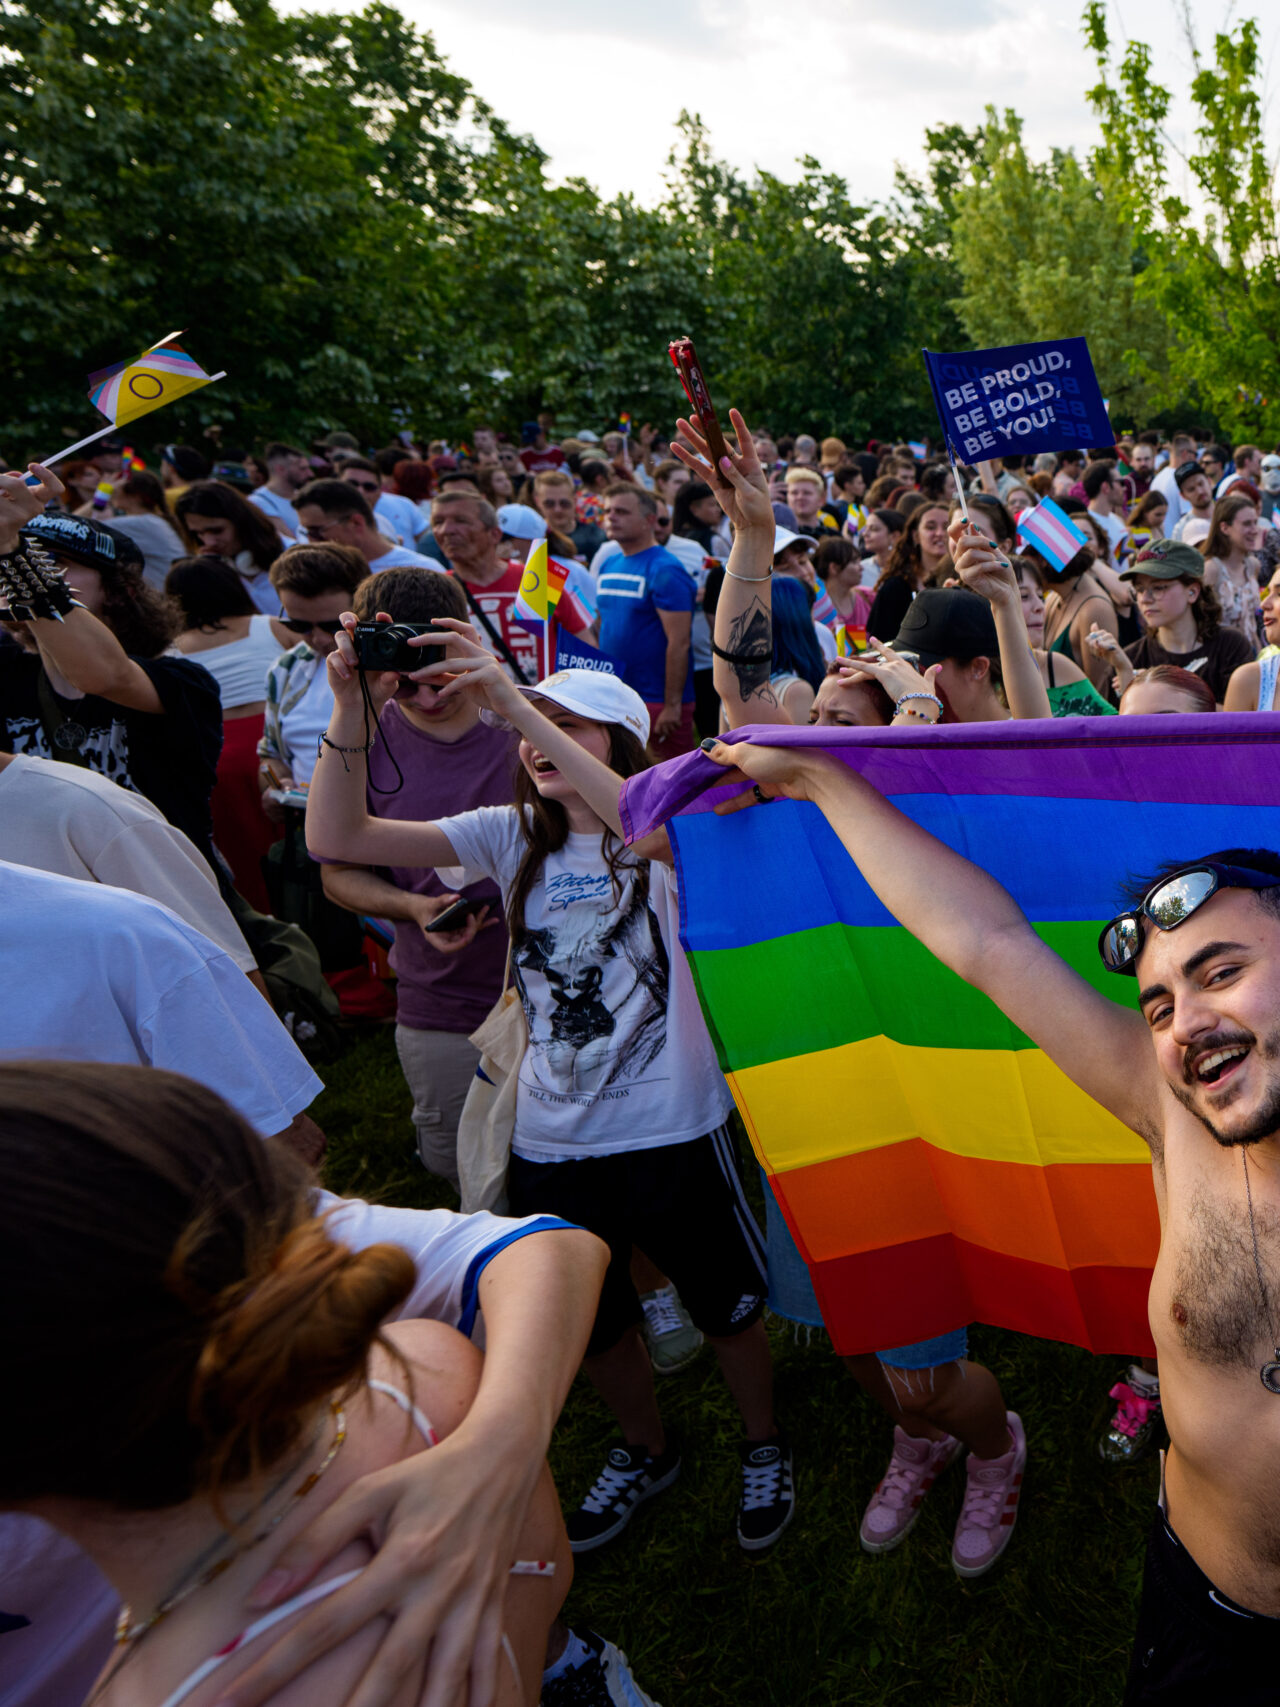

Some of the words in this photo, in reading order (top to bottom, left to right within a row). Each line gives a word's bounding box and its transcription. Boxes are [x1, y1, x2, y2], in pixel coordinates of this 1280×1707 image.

[944, 382, 979, 410] BE
[979, 351, 1072, 395] PROUD,
[954, 406, 987, 434] BE
[988, 381, 1062, 420] BOLD,
[963, 430, 997, 457] BE
[997, 405, 1057, 440] YOU!
[569, 655, 616, 675] PROUD,
[549, 1094, 567, 1104] THE
[602, 1088, 630, 1100] ENDS
